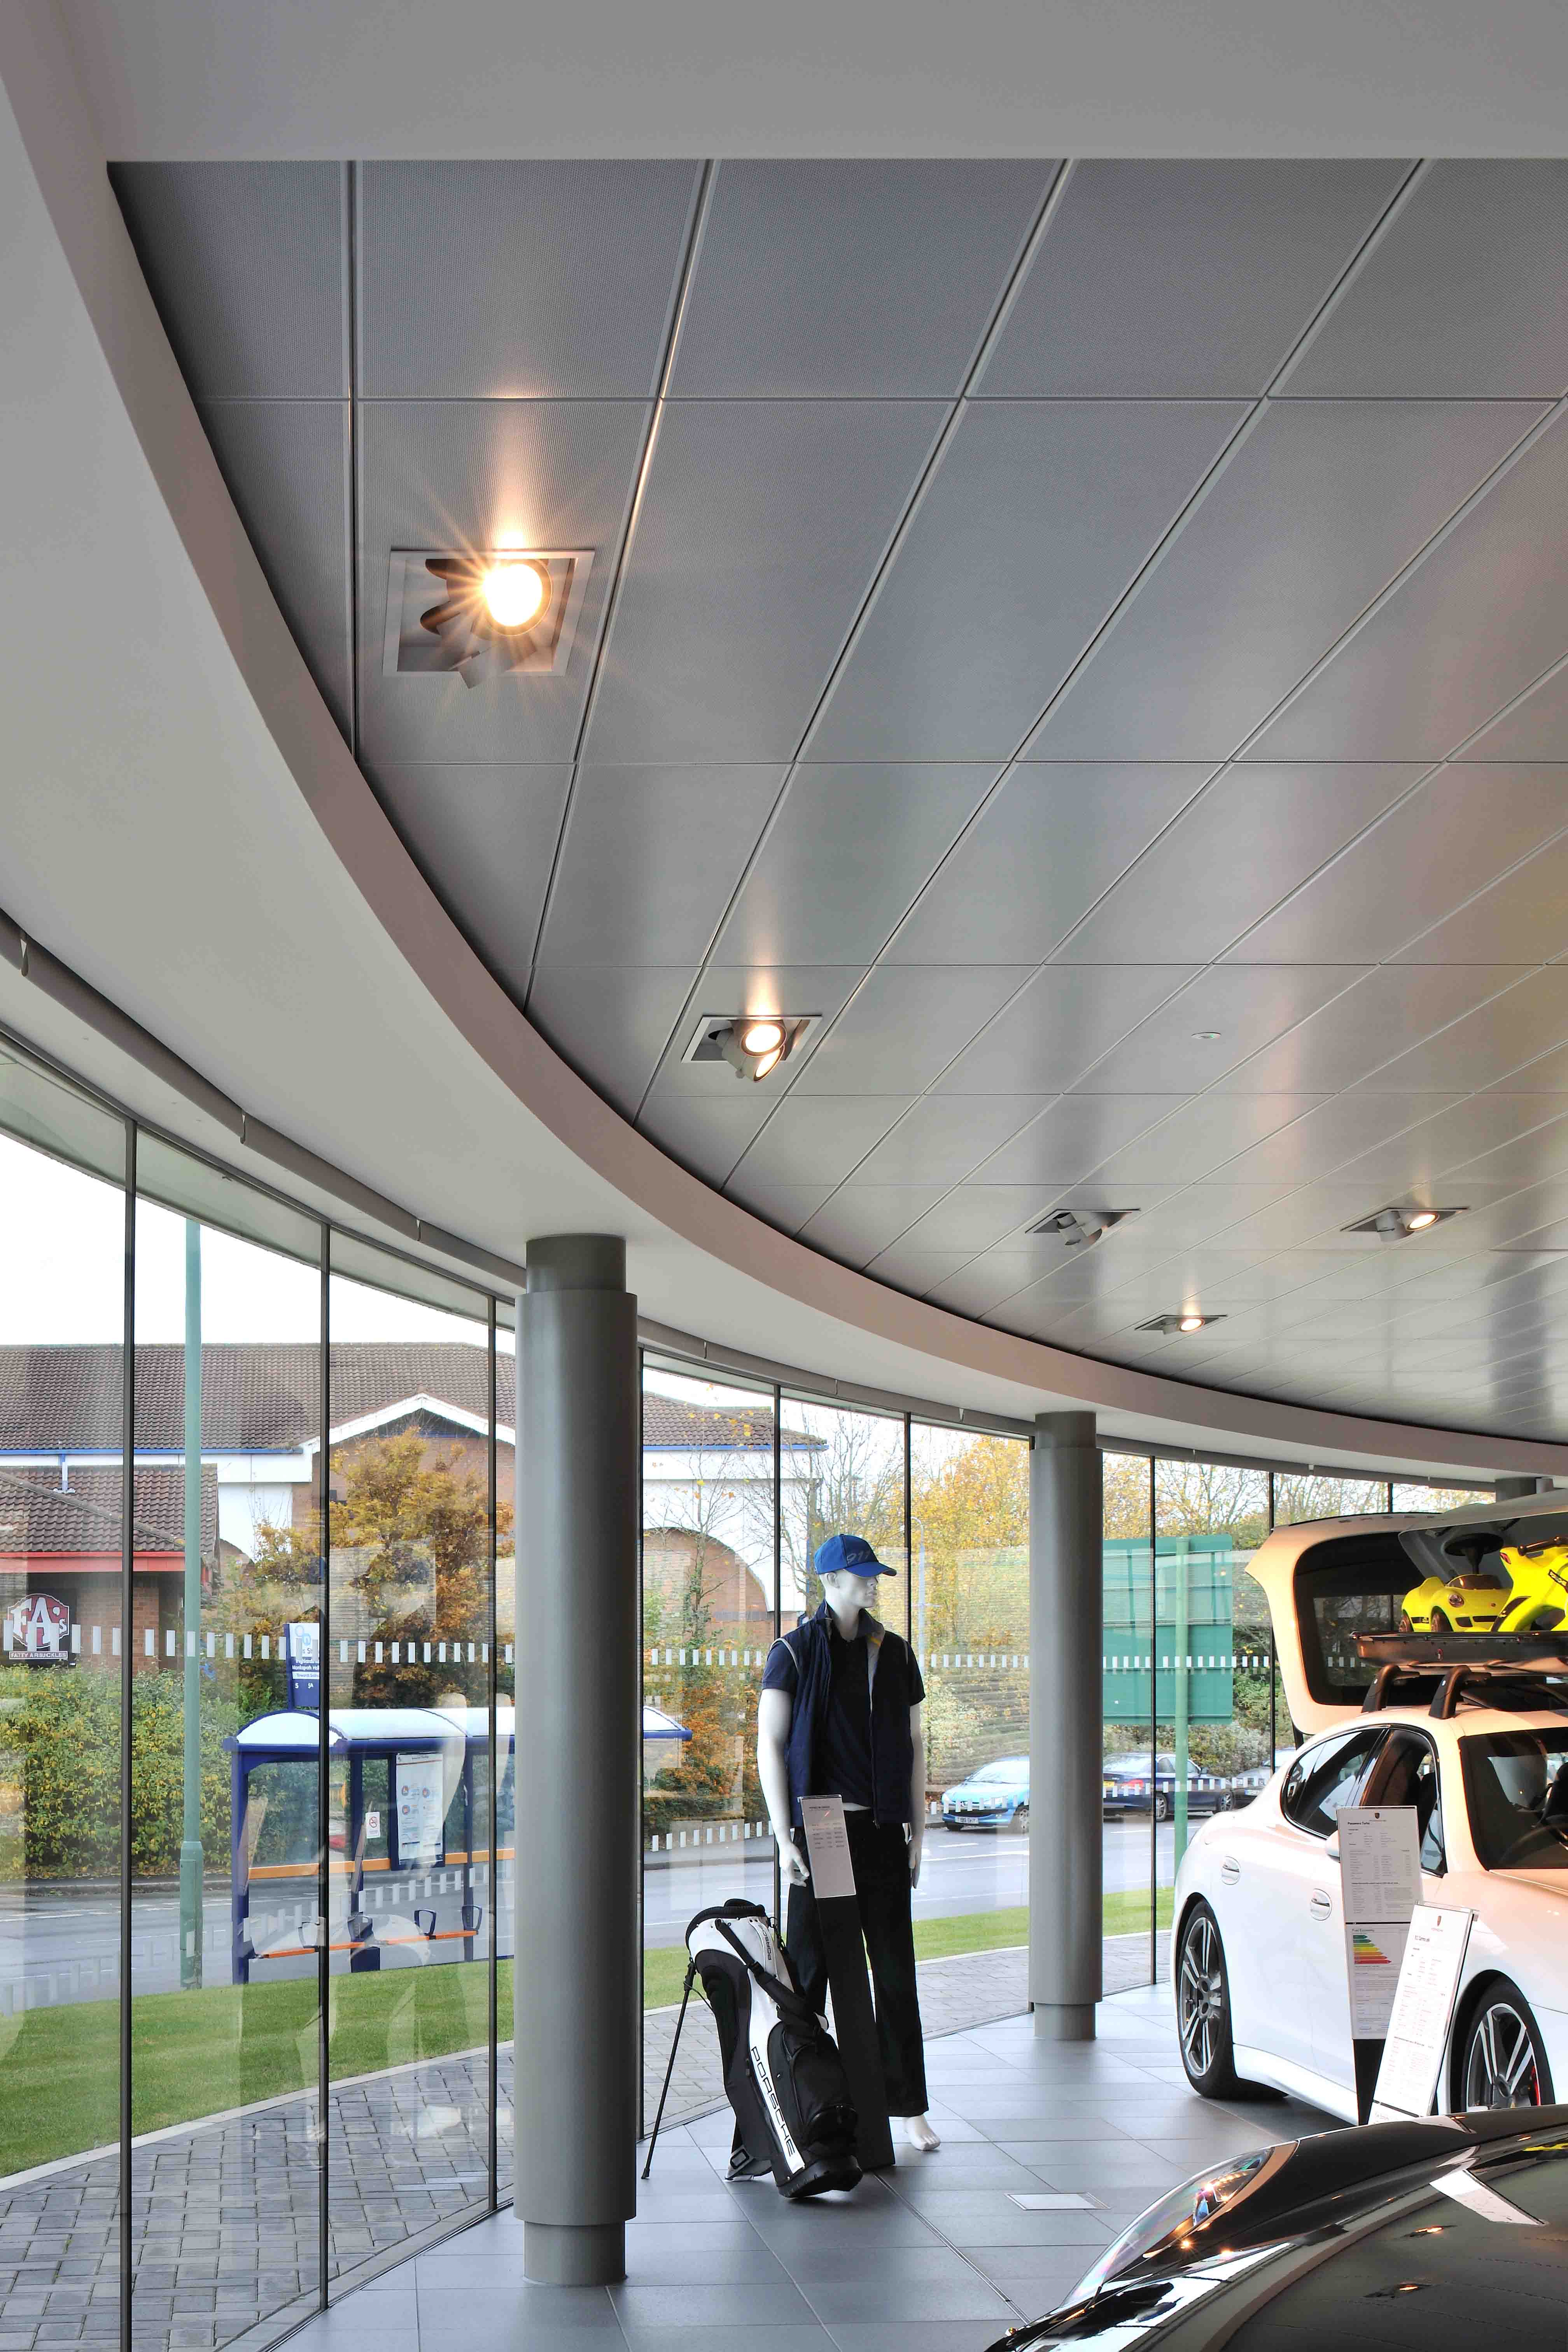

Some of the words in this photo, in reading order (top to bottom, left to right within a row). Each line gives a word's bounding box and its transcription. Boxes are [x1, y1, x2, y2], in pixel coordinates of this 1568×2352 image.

[846, 1550, 871, 1564] 911
[758, 1925, 772, 1960] PORSCHE
[751, 2046, 795, 2157] PORSCHE
